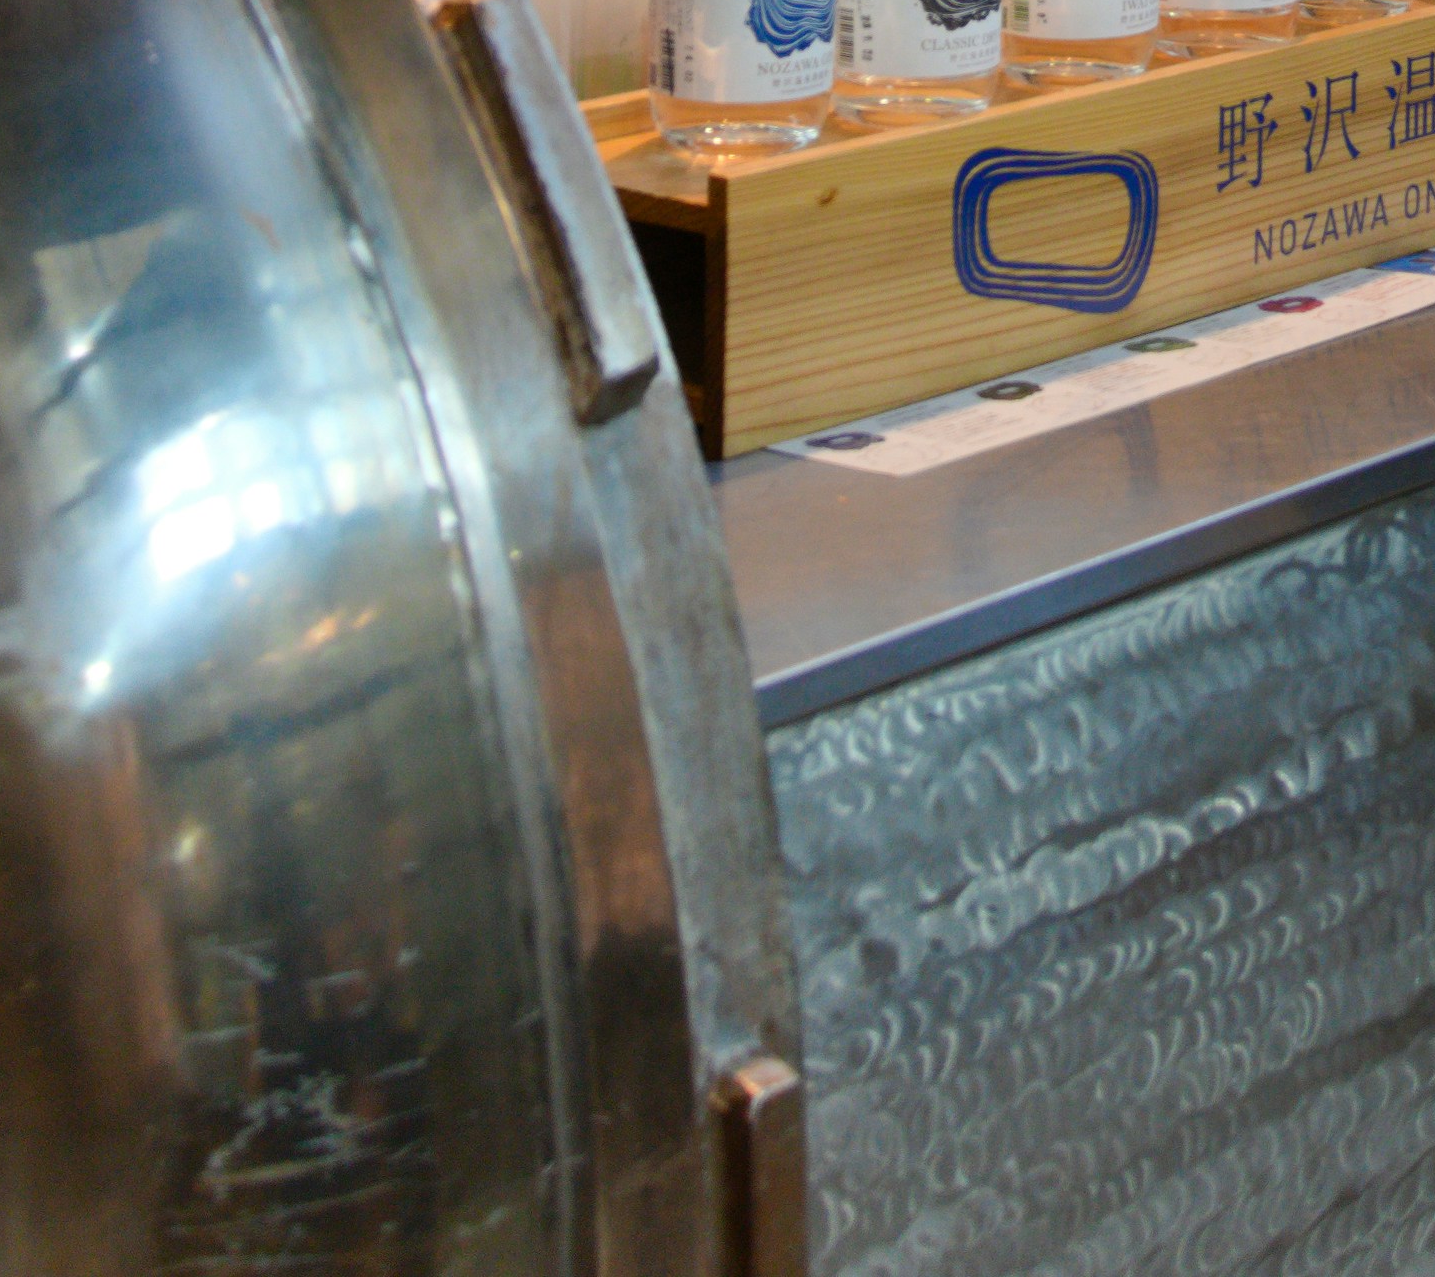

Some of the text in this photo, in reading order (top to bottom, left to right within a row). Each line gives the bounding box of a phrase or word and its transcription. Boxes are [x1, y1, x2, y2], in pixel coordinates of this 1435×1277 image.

[921, 35, 979, 51] CLASSIC
[757, 56, 819, 77] NOZAWA
[1252, 192, 1389, 265] NOZAWA
